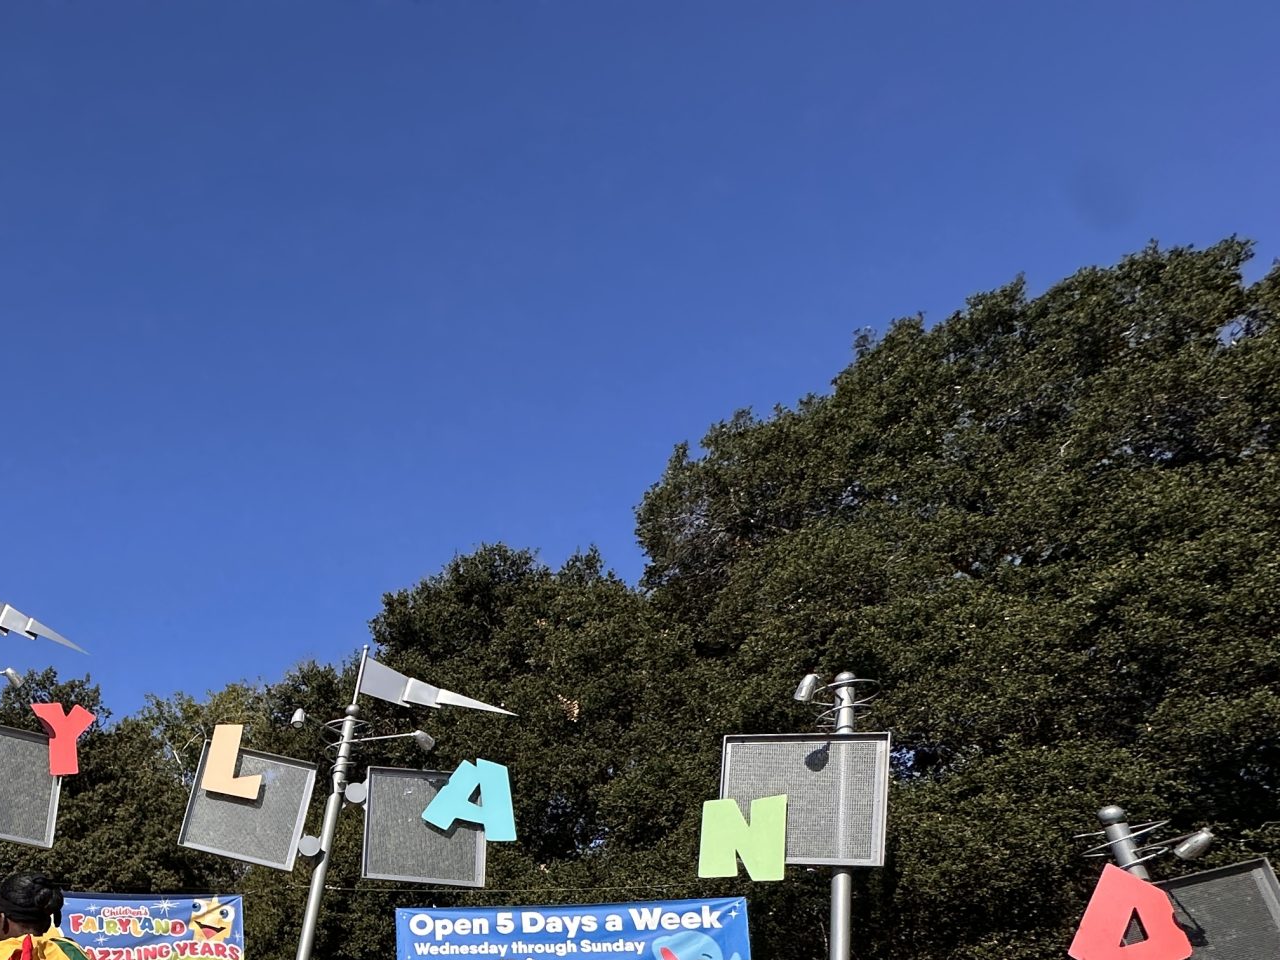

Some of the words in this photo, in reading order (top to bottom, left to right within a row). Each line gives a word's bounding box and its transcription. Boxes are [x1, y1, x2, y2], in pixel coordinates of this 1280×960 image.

[30, 702, 95, 776] Y
[201, 724, 262, 799] L
[421, 757, 518, 842] A
[698, 794, 788, 881] N
[101, 906, 149, 918] Children's
[408, 910, 490, 939] Open
[495, 912, 516, 935] 5
[521, 909, 599, 938] Days
[604, 911, 624, 932] a
[628, 905, 723, 931] Week
[70, 914, 186, 937] FAIRYLAND
[413, 942, 507, 957] Wednesday
[510, 941, 577, 956] through
[579, 938, 646, 955] Sunday
